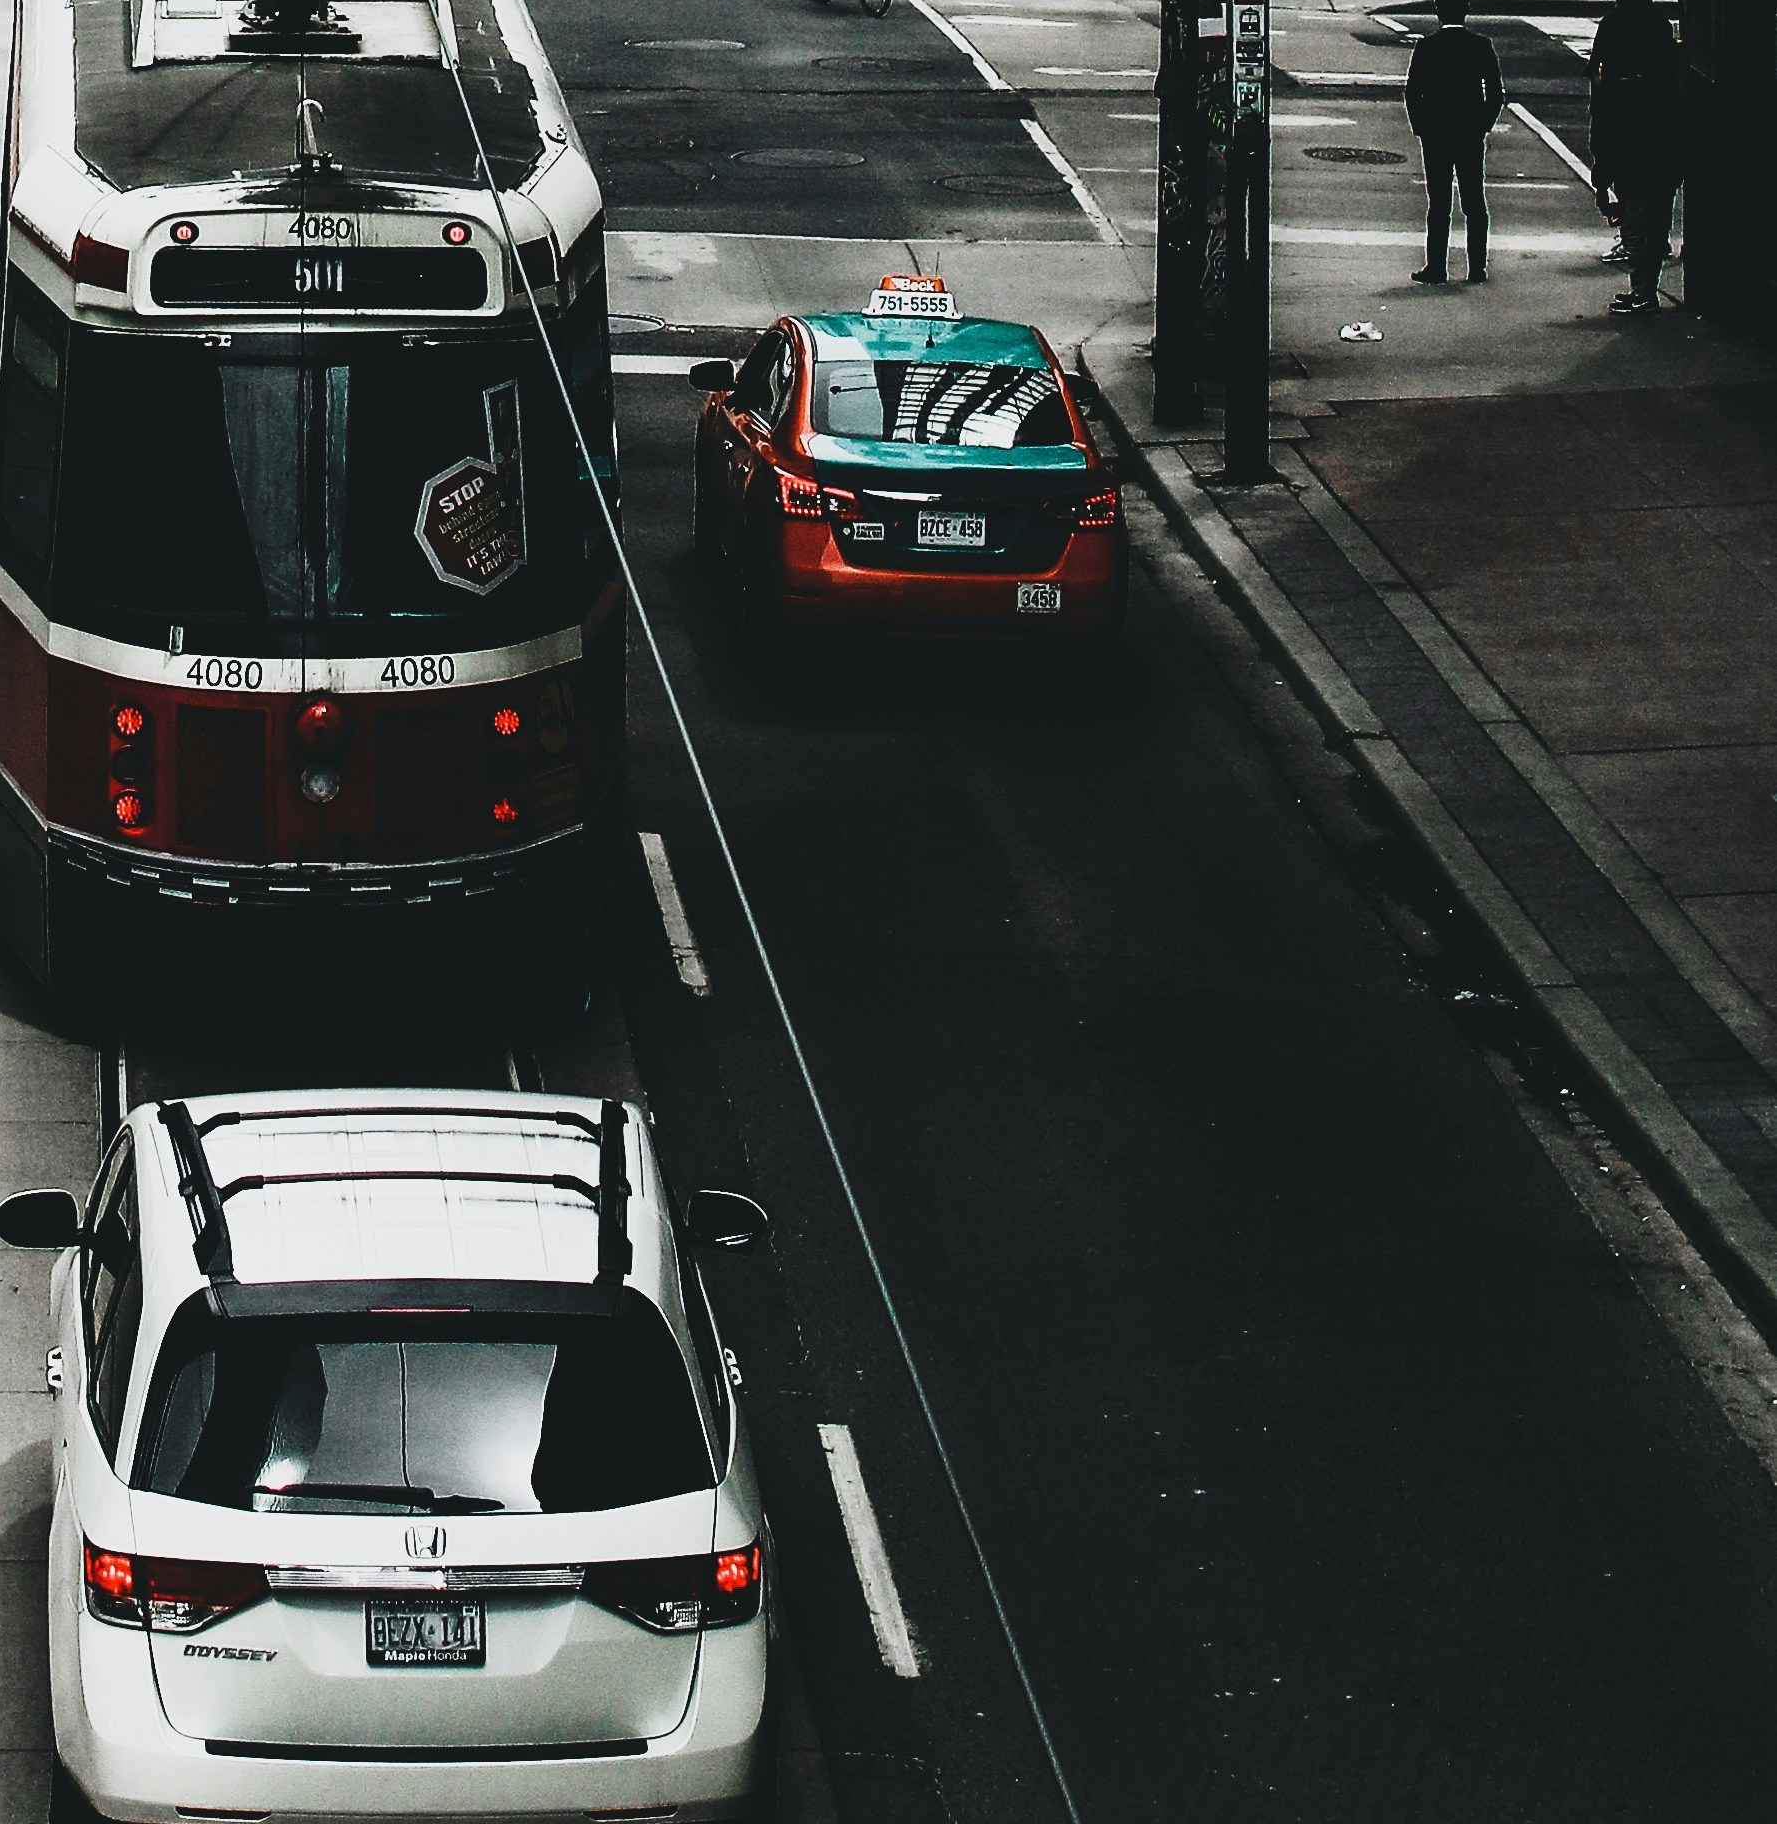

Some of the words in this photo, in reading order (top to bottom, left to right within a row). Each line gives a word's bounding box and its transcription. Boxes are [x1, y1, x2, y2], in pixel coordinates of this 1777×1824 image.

[288, 216, 351, 240] 4080
[294, 258, 343, 294] 501
[901, 279, 935, 292] Beck
[878, 295, 948, 313] 751-5555
[438, 476, 485, 514] STOP
[959, 519, 983, 538] 458
[1022, 589, 1058, 608] 3458
[186, 659, 263, 690] 4080
[380, 656, 456, 686] 4080
[183, 1643, 279, 1662] ODYSSEY
